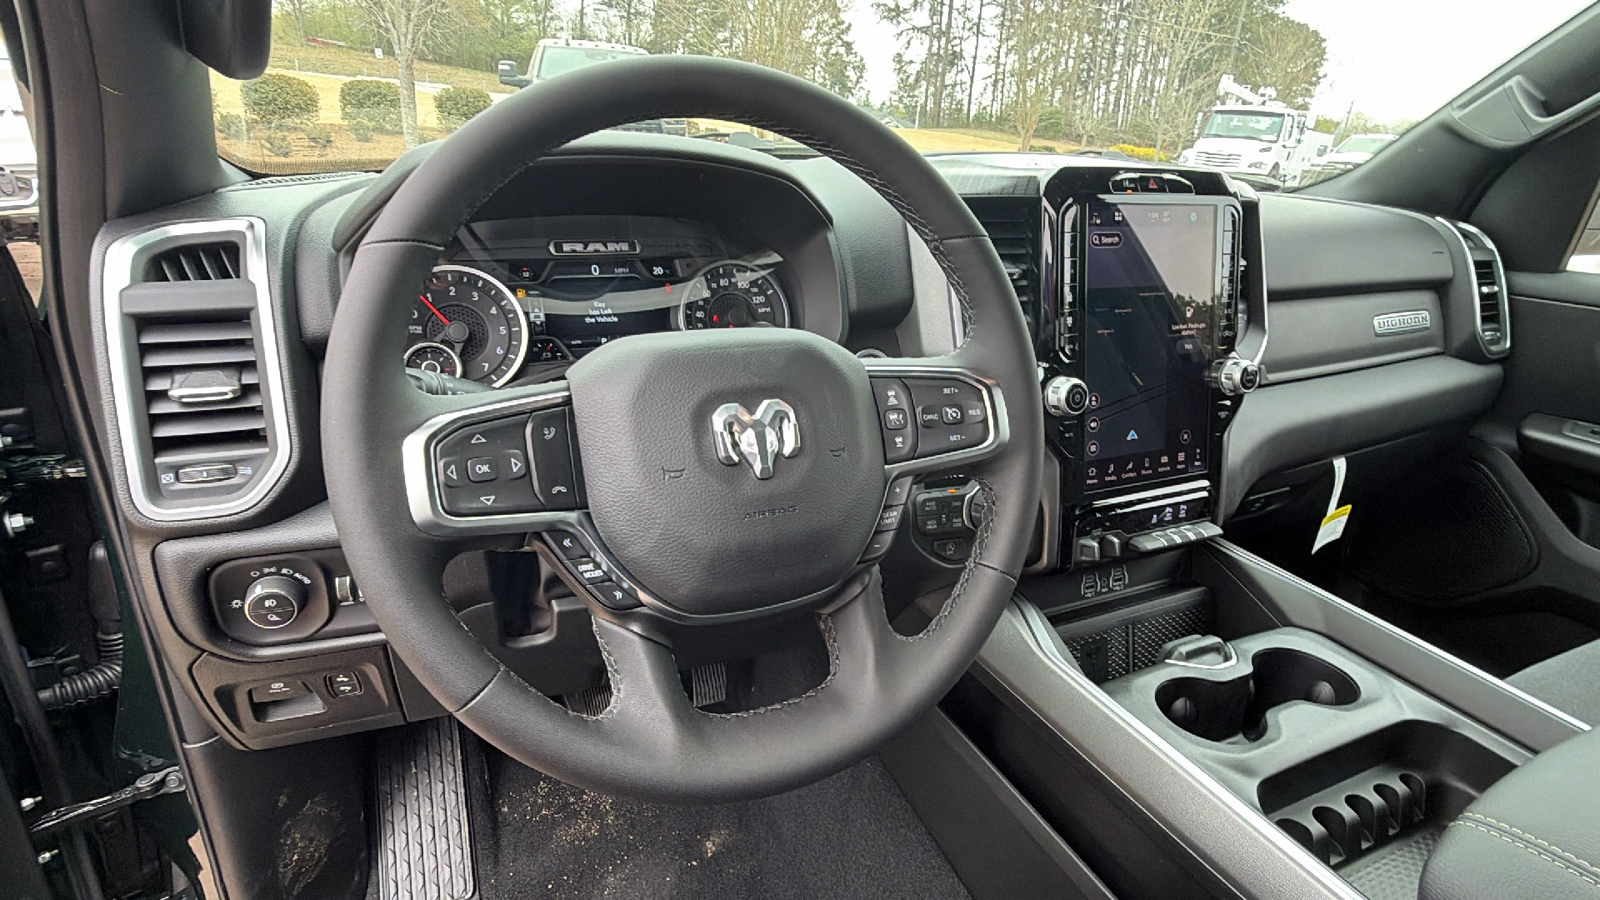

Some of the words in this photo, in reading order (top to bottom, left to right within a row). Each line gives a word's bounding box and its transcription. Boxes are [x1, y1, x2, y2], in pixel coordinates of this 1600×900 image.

[1101, 235, 1120, 244] Search
[562, 242, 630, 253] RAM
[591, 264, 600, 276] 0
[652, 266, 664, 275] 20
[719, 277, 729, 287] 80
[737, 281, 750, 289] 100
[448, 286, 456, 296] 2
[702, 289, 711, 298] 60
[426, 292, 433, 303] 1
[471, 291, 479, 301] 3
[752, 295, 766, 304] 120
[489, 306, 498, 315] 4
[695, 310, 705, 318] 40
[596, 315, 619, 323] Vehicle
[499, 326, 507, 335] 5
[496, 346, 504, 355] 6
[481, 362, 489, 372] 7
[968, 408, 982, 416] RES
[922, 413, 939, 421] CANC
[475, 463, 491, 474] OK
[743, 504, 799, 521] AIRBAG
[578, 563, 595, 572] DRIVE
[293, 572, 312, 585] AUTO
